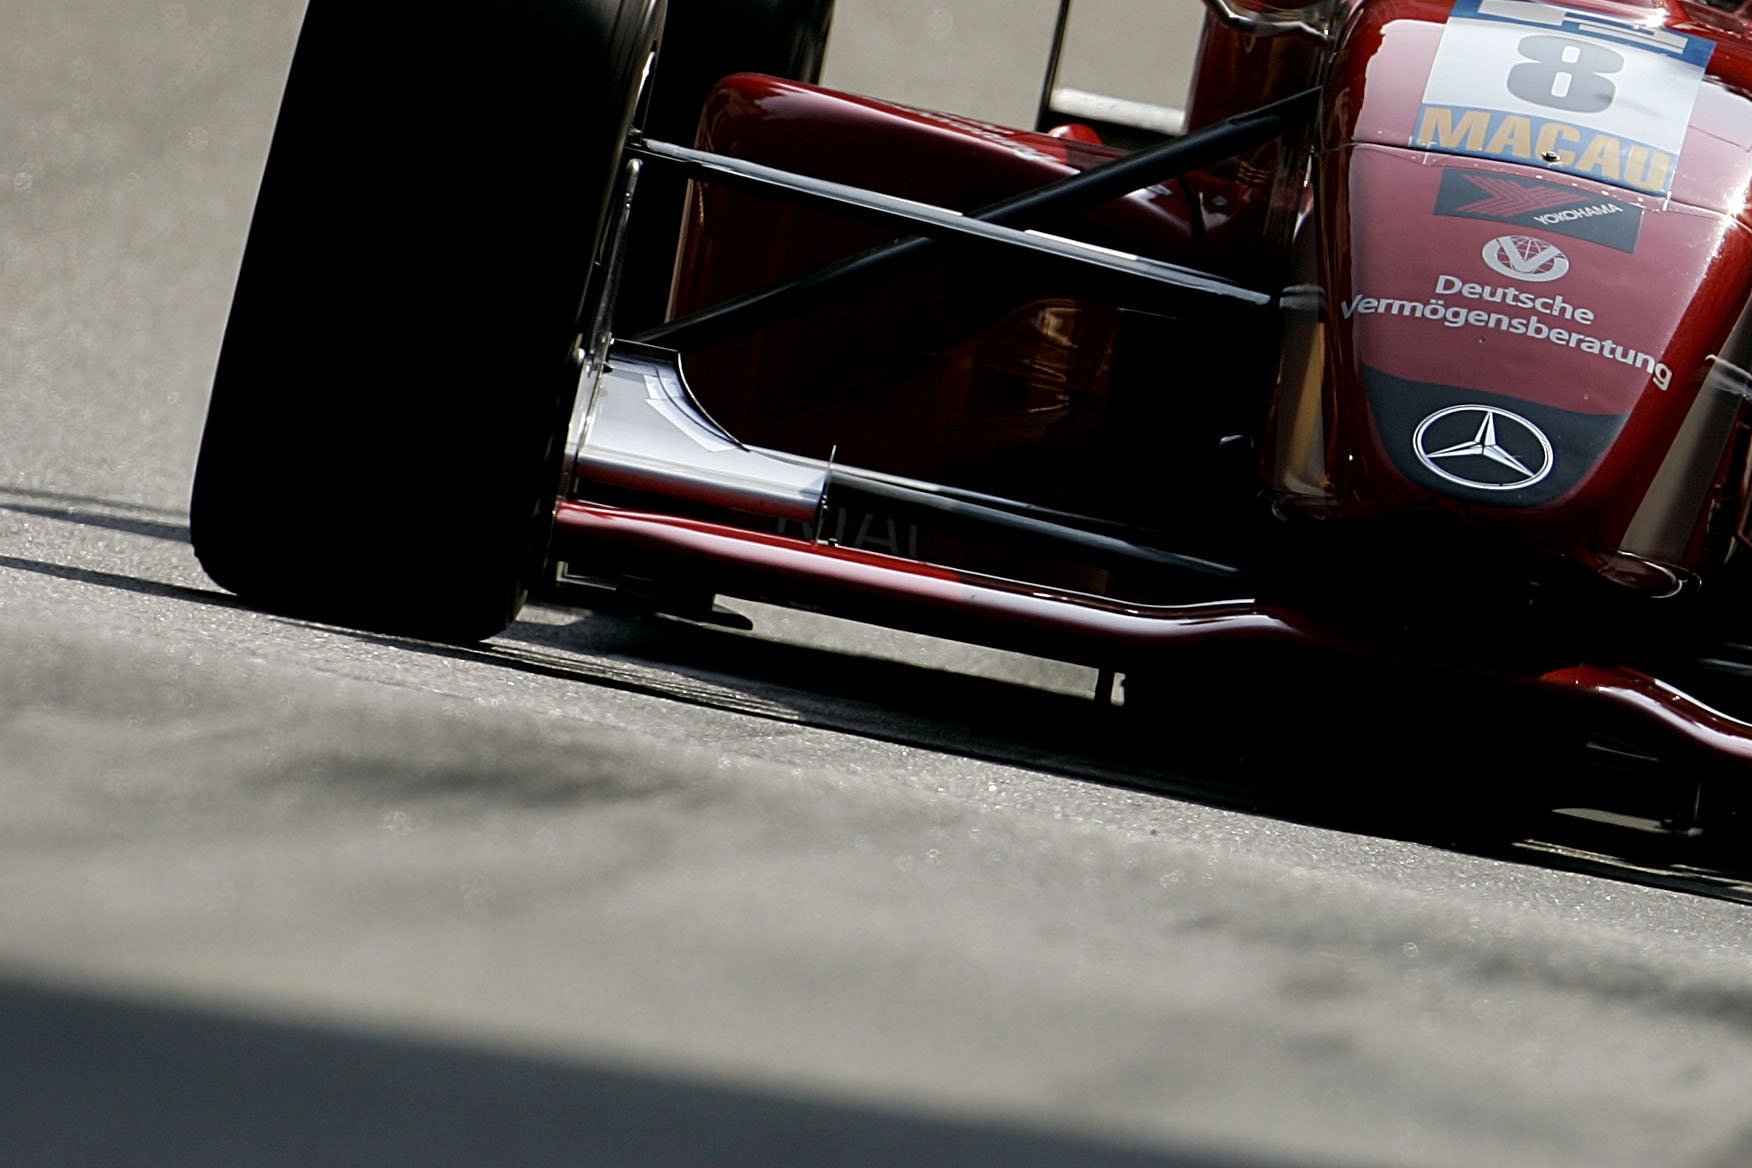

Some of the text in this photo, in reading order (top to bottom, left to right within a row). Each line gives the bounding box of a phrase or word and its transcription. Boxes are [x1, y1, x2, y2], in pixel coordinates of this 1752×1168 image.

[1505, 34, 1625, 114] 8
[1416, 106, 1674, 193] MACAU
[1533, 203, 1624, 225] YOKOHAMA
[1435, 274, 1595, 325] Deutsche
[1341, 293, 1673, 391] Vermögensberatung
